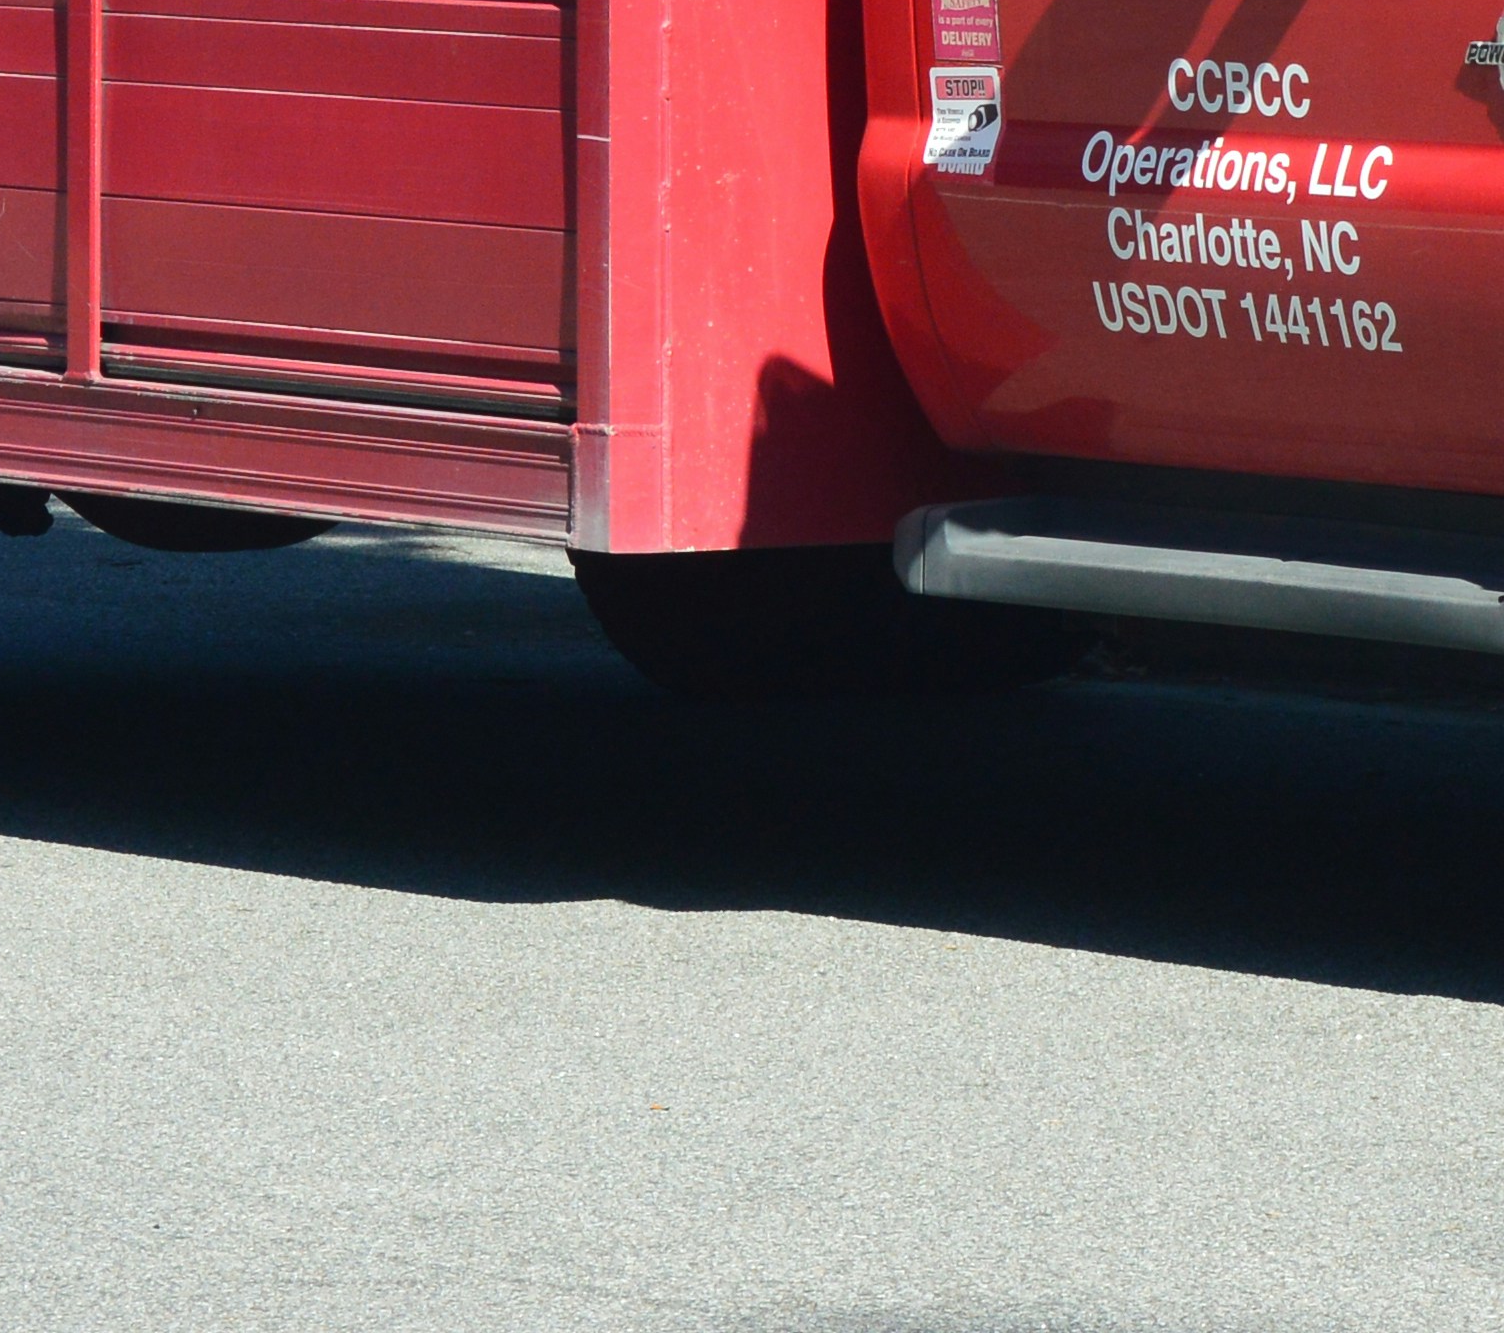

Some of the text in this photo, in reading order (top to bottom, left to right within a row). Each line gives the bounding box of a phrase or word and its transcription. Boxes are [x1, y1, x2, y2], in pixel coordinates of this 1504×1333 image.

[938, 16, 945, 25] is
[951, 16, 966, 27] part
[966, 16, 974, 25] of
[974, 18, 994, 28] every
[941, 31, 992, 46] DELIVERY
[945, 79, 985, 97] STOP!!
[1167, 58, 1311, 118] CCBCC
[1082, 130, 1394, 205] Operations, LLC
[1107, 207, 1361, 281] Charlotte, NC
[1093, 281, 1403, 353] USDOT 1441162
